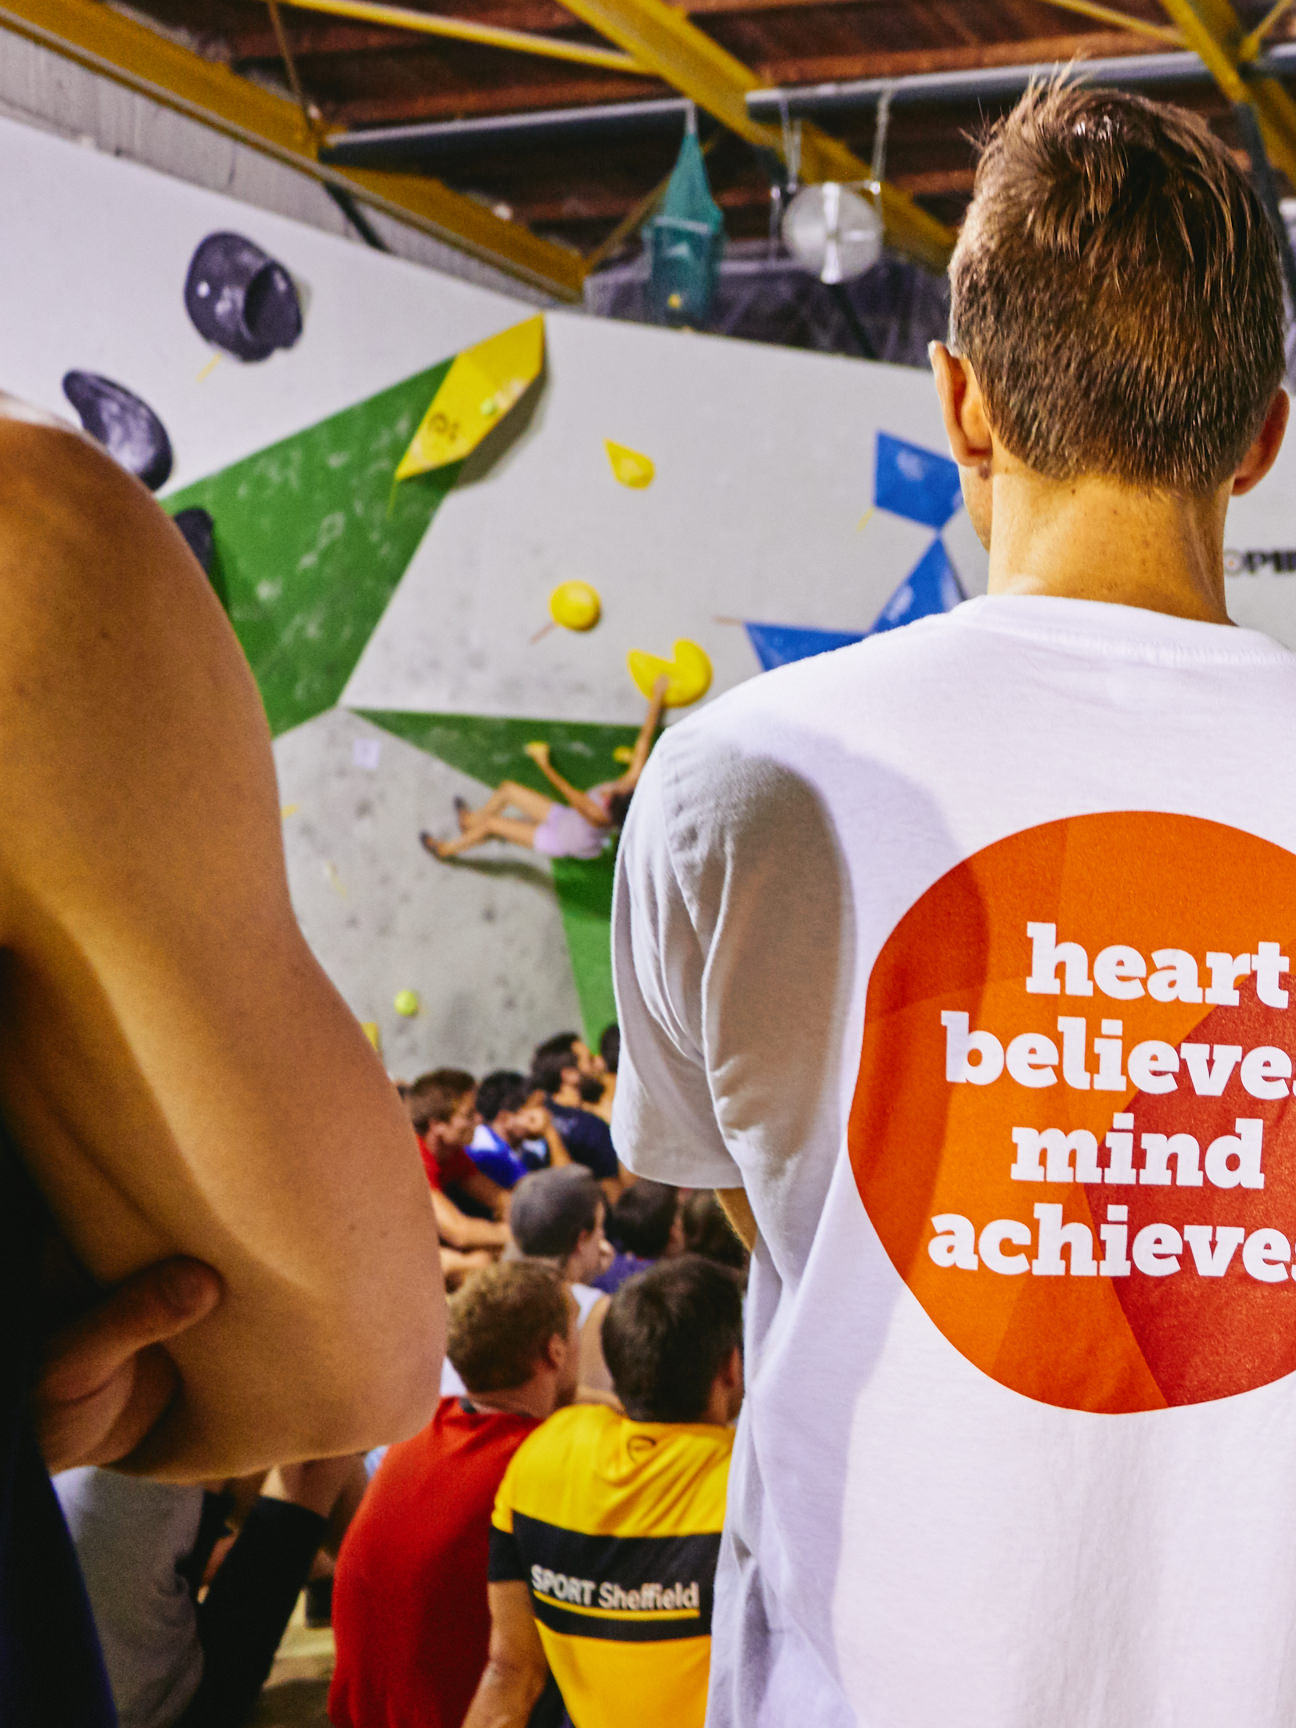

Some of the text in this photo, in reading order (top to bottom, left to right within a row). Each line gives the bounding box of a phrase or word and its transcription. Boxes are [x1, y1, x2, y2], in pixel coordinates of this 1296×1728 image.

[1025, 921, 1290, 1009] heart
[1010, 1112, 1265, 1190] mind
[531, 1564, 700, 1610] SPORT Sheffield
